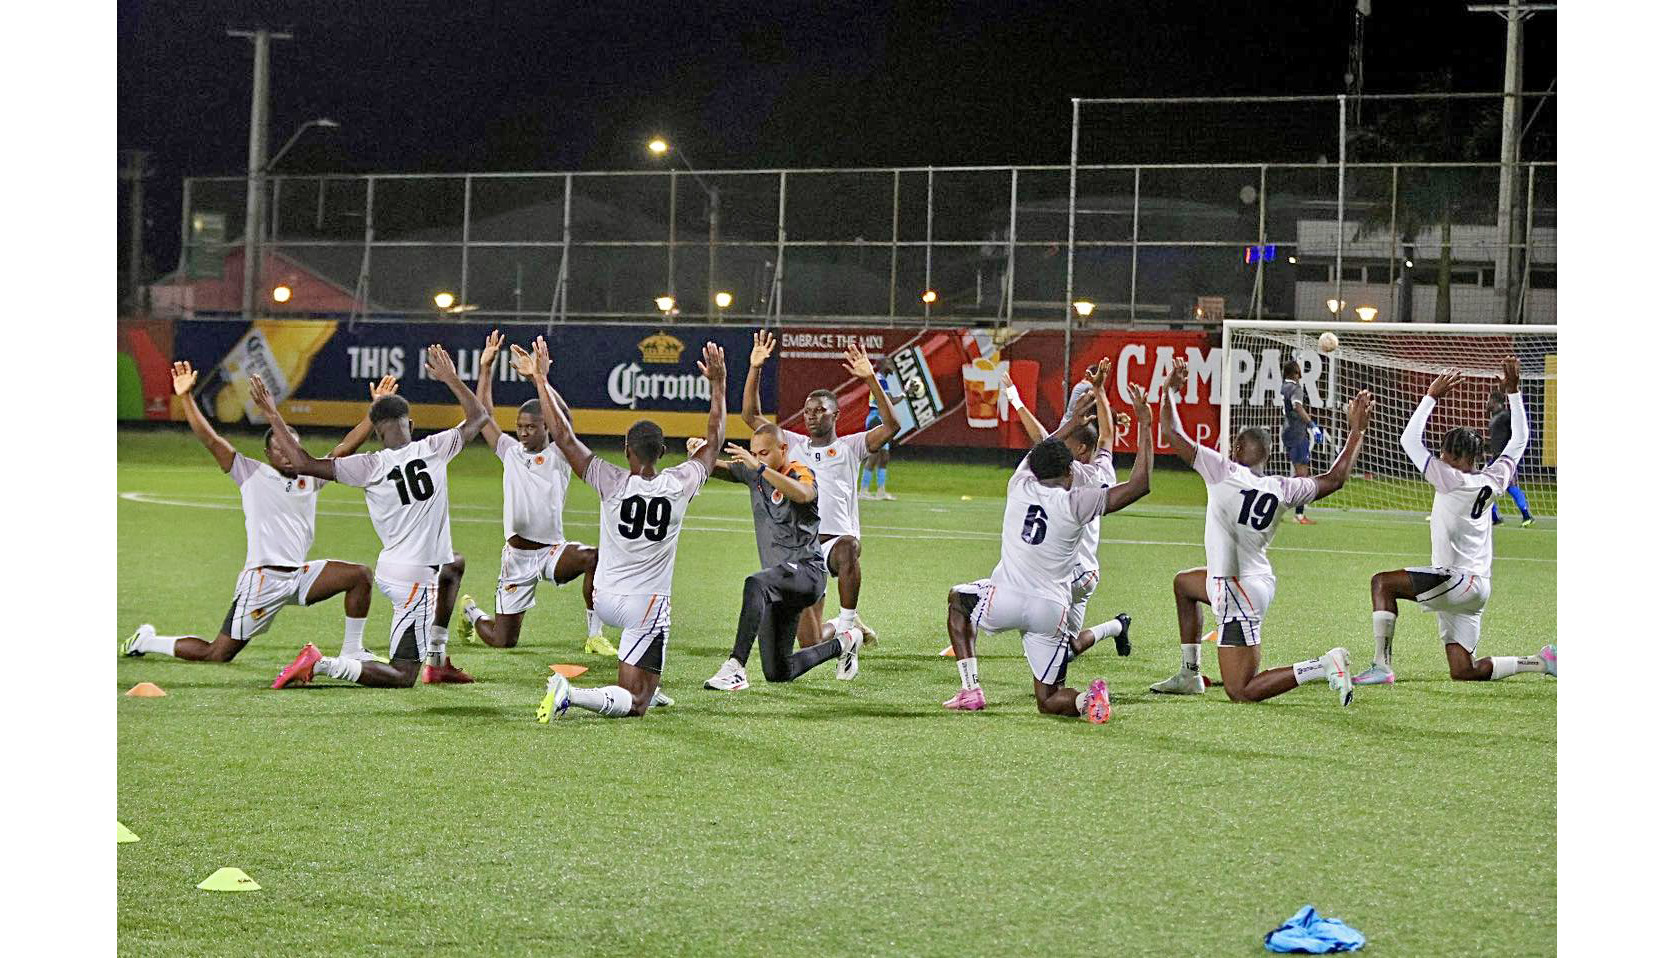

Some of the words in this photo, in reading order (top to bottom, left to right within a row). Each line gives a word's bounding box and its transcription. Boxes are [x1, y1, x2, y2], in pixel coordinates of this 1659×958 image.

[781, 334, 833, 348] EMBRACE
[836, 336, 857, 348] THE
[348, 347, 405, 380] THIS
[1117, 344, 1334, 408] CAMPARI
[607, 362, 712, 410] Corona
[387, 459, 434, 505] 16
[1471, 485, 1492, 519] 8
[618, 494, 671, 541] 99
[1021, 504, 1048, 545] 6
[1237, 488, 1279, 531] 19
